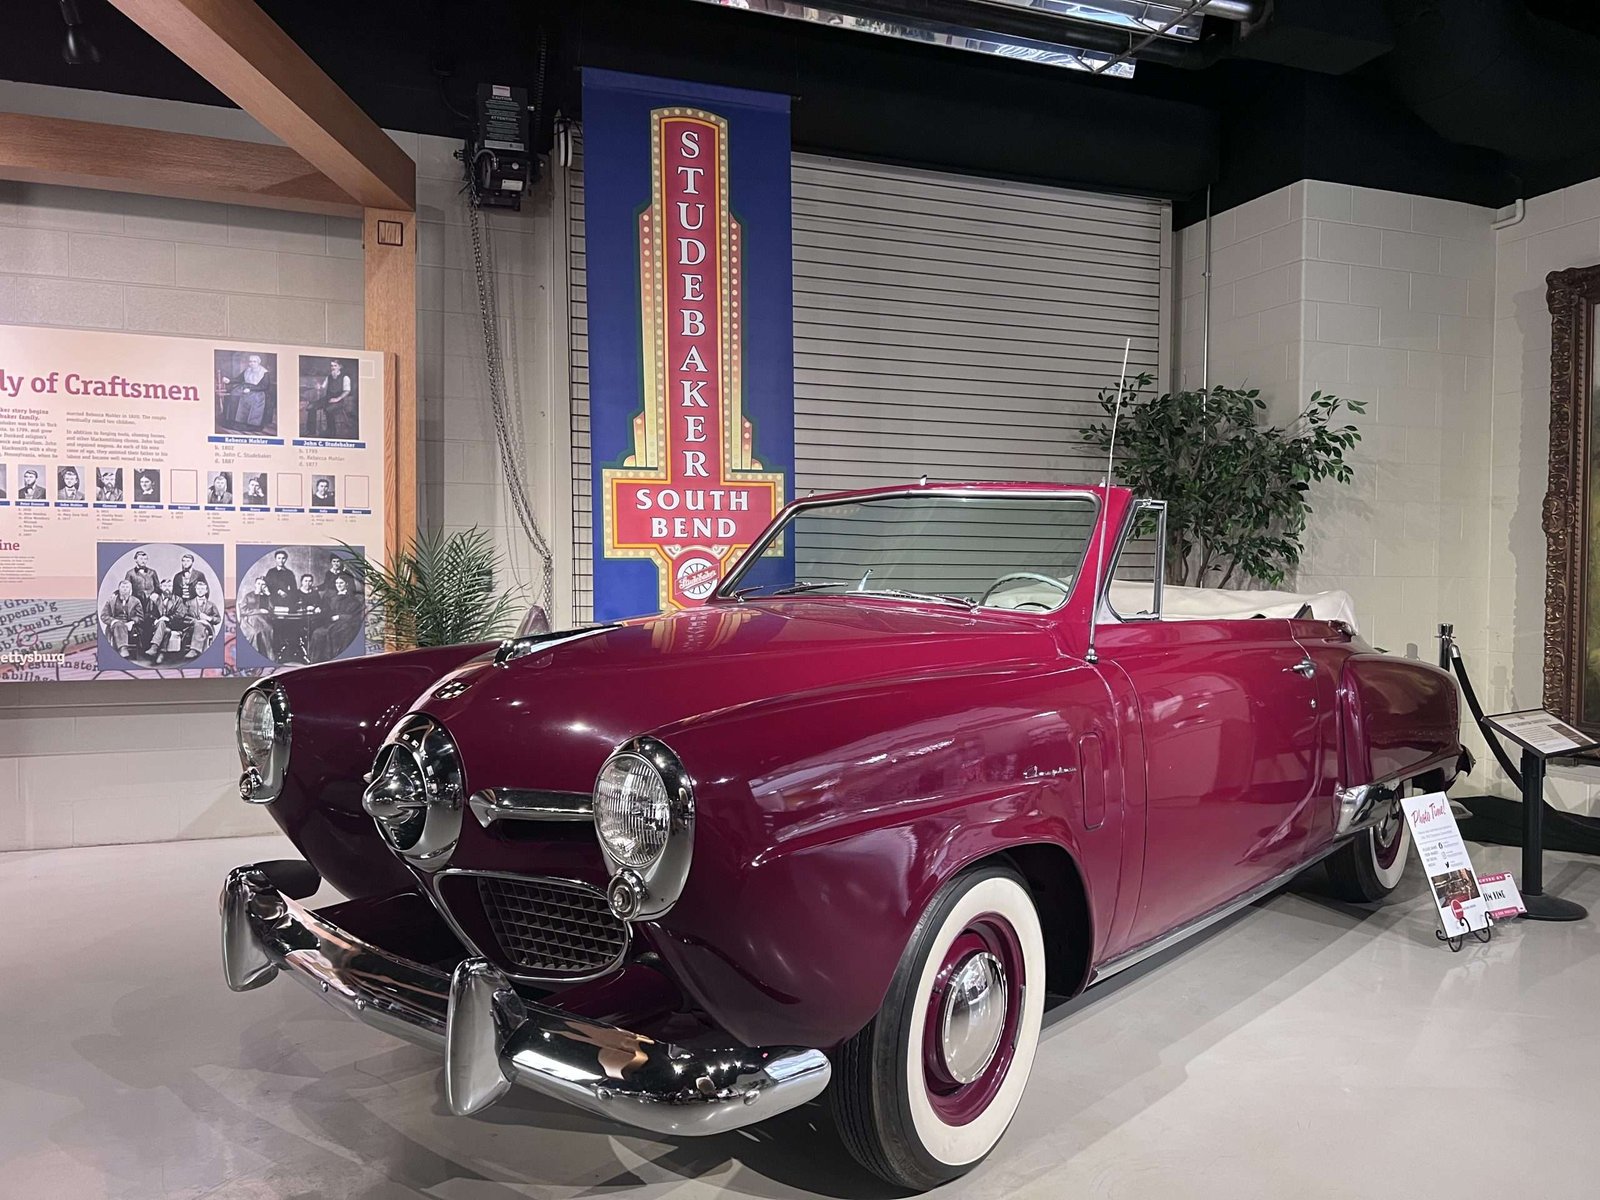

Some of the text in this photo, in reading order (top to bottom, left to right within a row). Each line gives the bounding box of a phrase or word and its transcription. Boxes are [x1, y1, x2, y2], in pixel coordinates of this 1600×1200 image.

[677, 131, 710, 477] STUDEBAKER
[31, 372, 59, 393] of
[65, 373, 200, 401] Craftsmen
[636, 488, 750, 512] SOUTH
[650, 517, 737, 539] BEND
[0, 651, 65, 666] ettysburg
[1411, 809, 1431, 828] Photo
